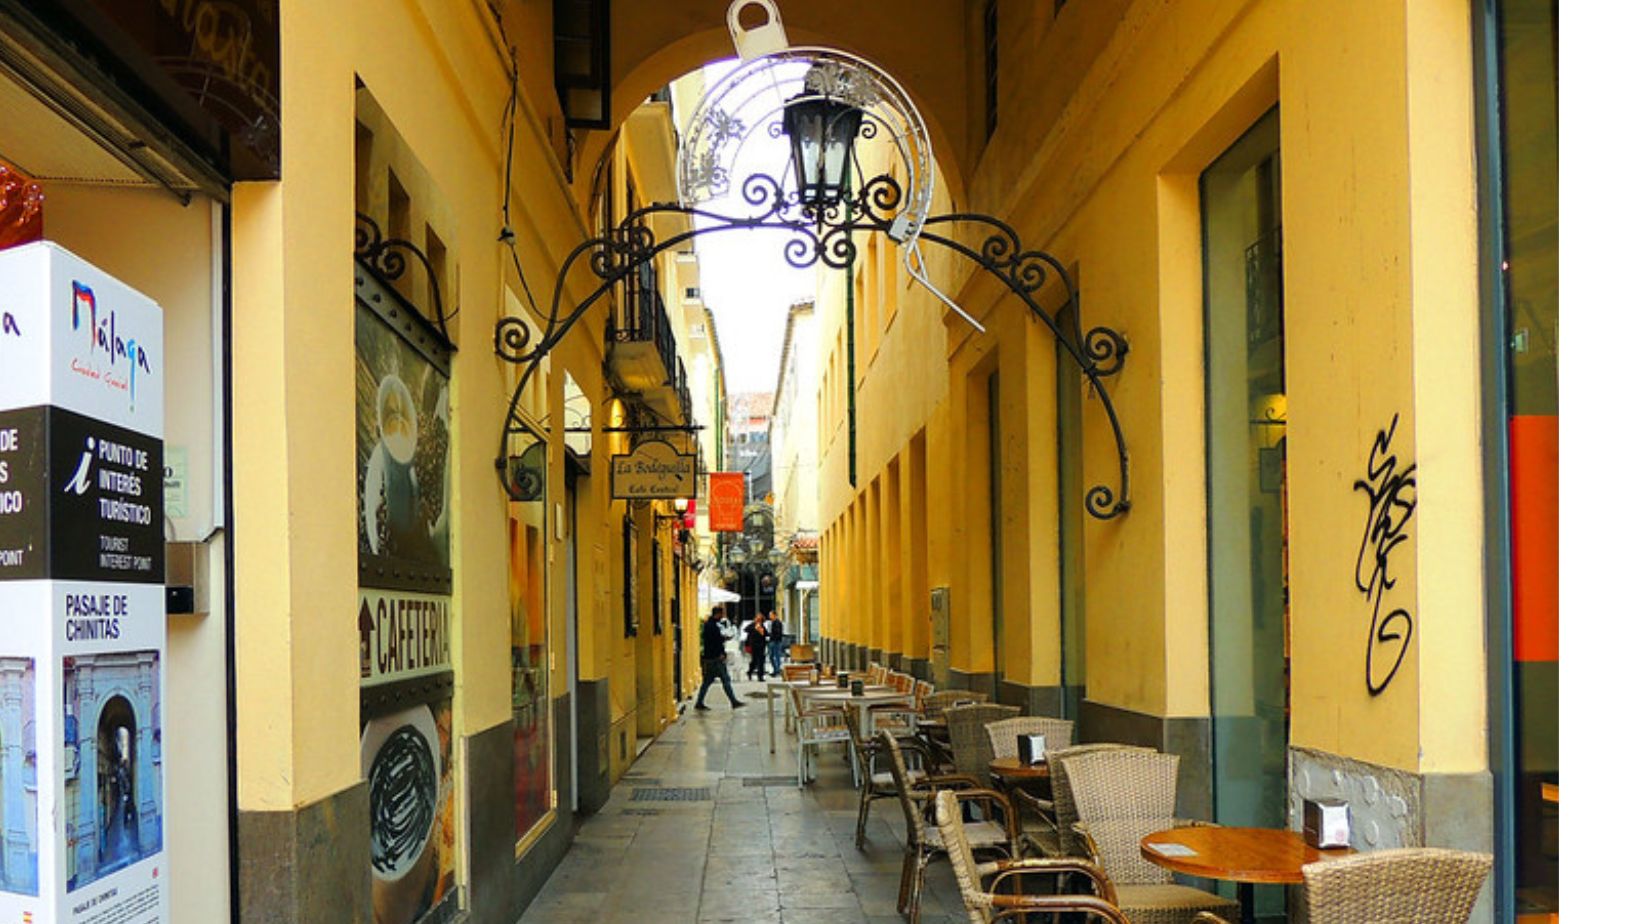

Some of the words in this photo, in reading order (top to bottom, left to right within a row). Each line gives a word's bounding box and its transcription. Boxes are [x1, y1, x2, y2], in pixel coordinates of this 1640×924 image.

[72, 280, 150, 401] Málaga
[99, 439, 133, 467] PUNTO
[135, 449, 148, 471] DE
[99, 468, 142, 496] INTERÉS
[99, 497, 151, 525] TURÍSTICO
[100, 535, 129, 551] TOURIST
[100, 554, 132, 570] INTEREST
[66, 594, 110, 616] PASAJE
[113, 594, 128, 616] DE
[66, 617, 120, 641] CHINITAS
[377, 597, 451, 674] CAFETERIA
